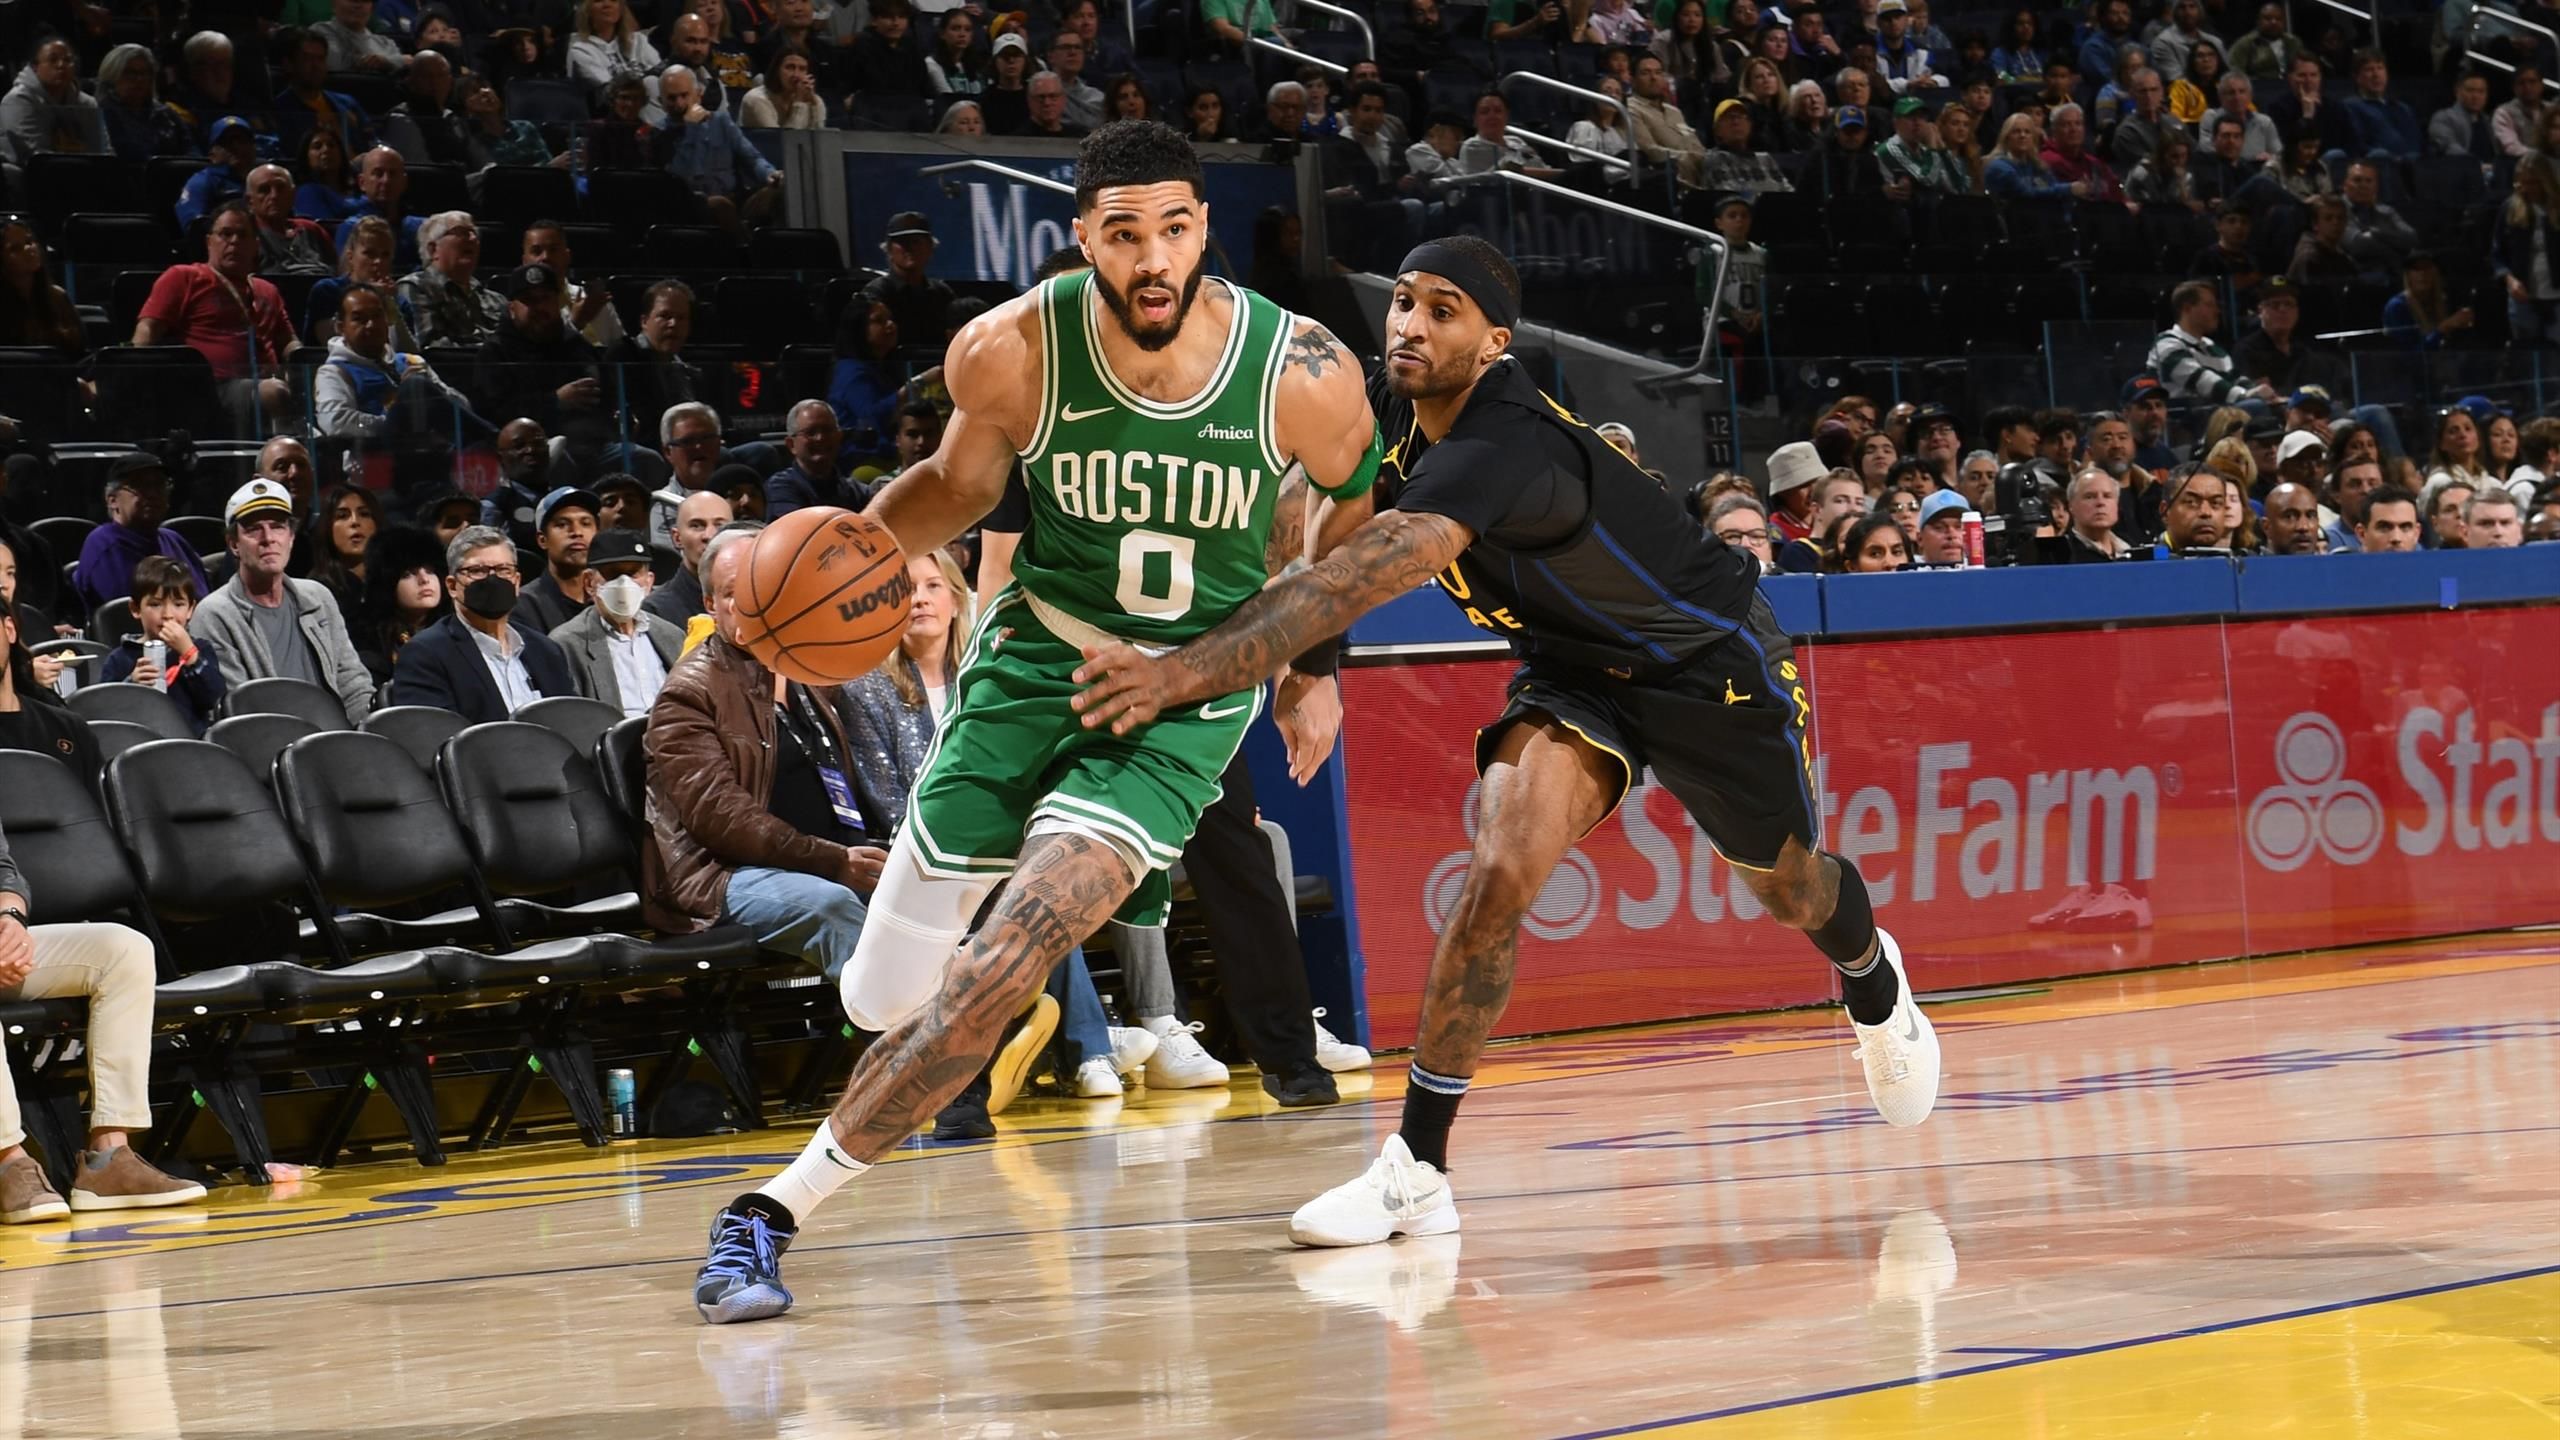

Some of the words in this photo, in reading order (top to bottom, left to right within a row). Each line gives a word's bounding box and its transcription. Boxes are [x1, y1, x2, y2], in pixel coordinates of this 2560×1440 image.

[1197, 423, 1254, 440] Amica
[1711, 416, 1728, 434] 12
[1712, 444, 1729, 462] 11
[1052, 450, 1261, 530] BOSTON
[1115, 528, 1196, 621] 0
